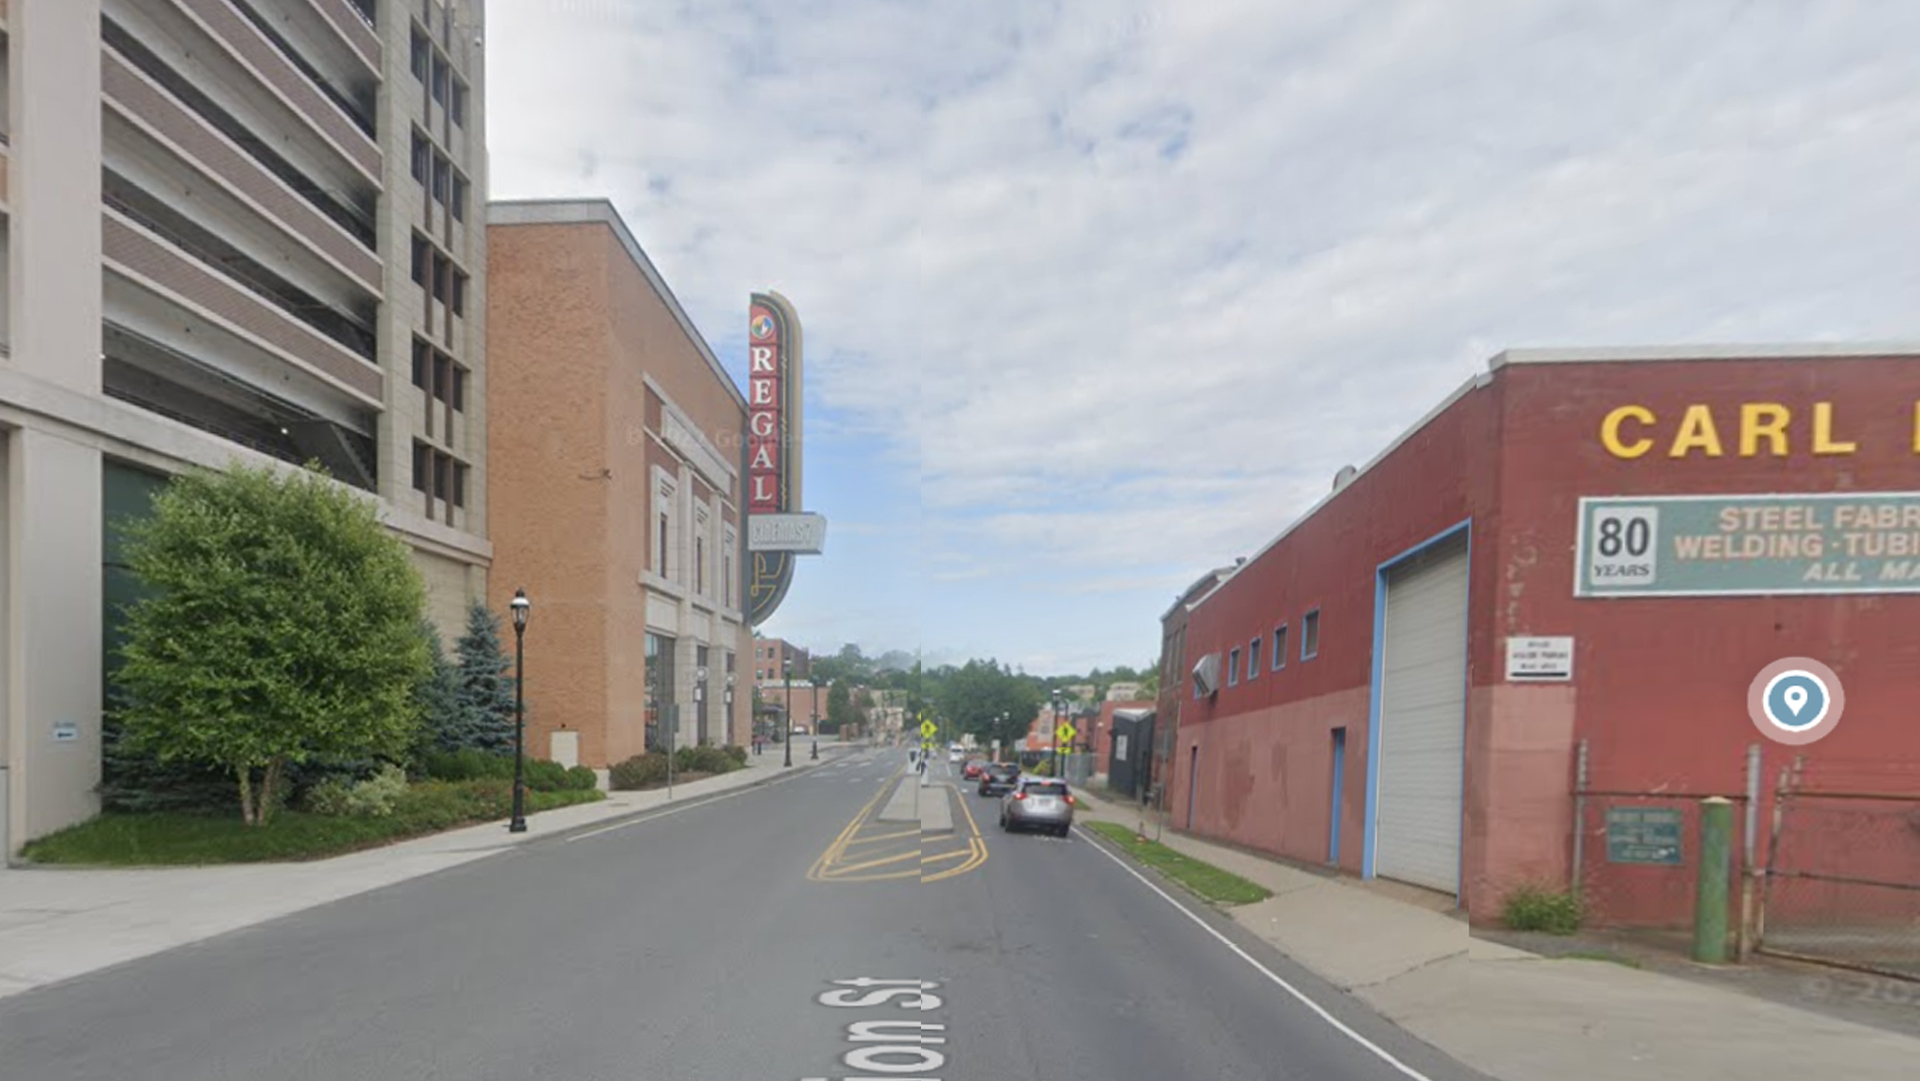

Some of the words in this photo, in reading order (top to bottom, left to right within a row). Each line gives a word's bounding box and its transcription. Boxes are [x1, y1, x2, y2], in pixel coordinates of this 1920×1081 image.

[751, 346, 774, 501] REGAL
[1601, 402, 1856, 460] CARL
[1719, 505, 1823, 533] STEEL
[1598, 516, 1650, 557] 80
[1674, 532, 1823, 560] WELDING
[1593, 564, 1650, 577] YEARS
[1803, 560, 1862, 581] ALL
